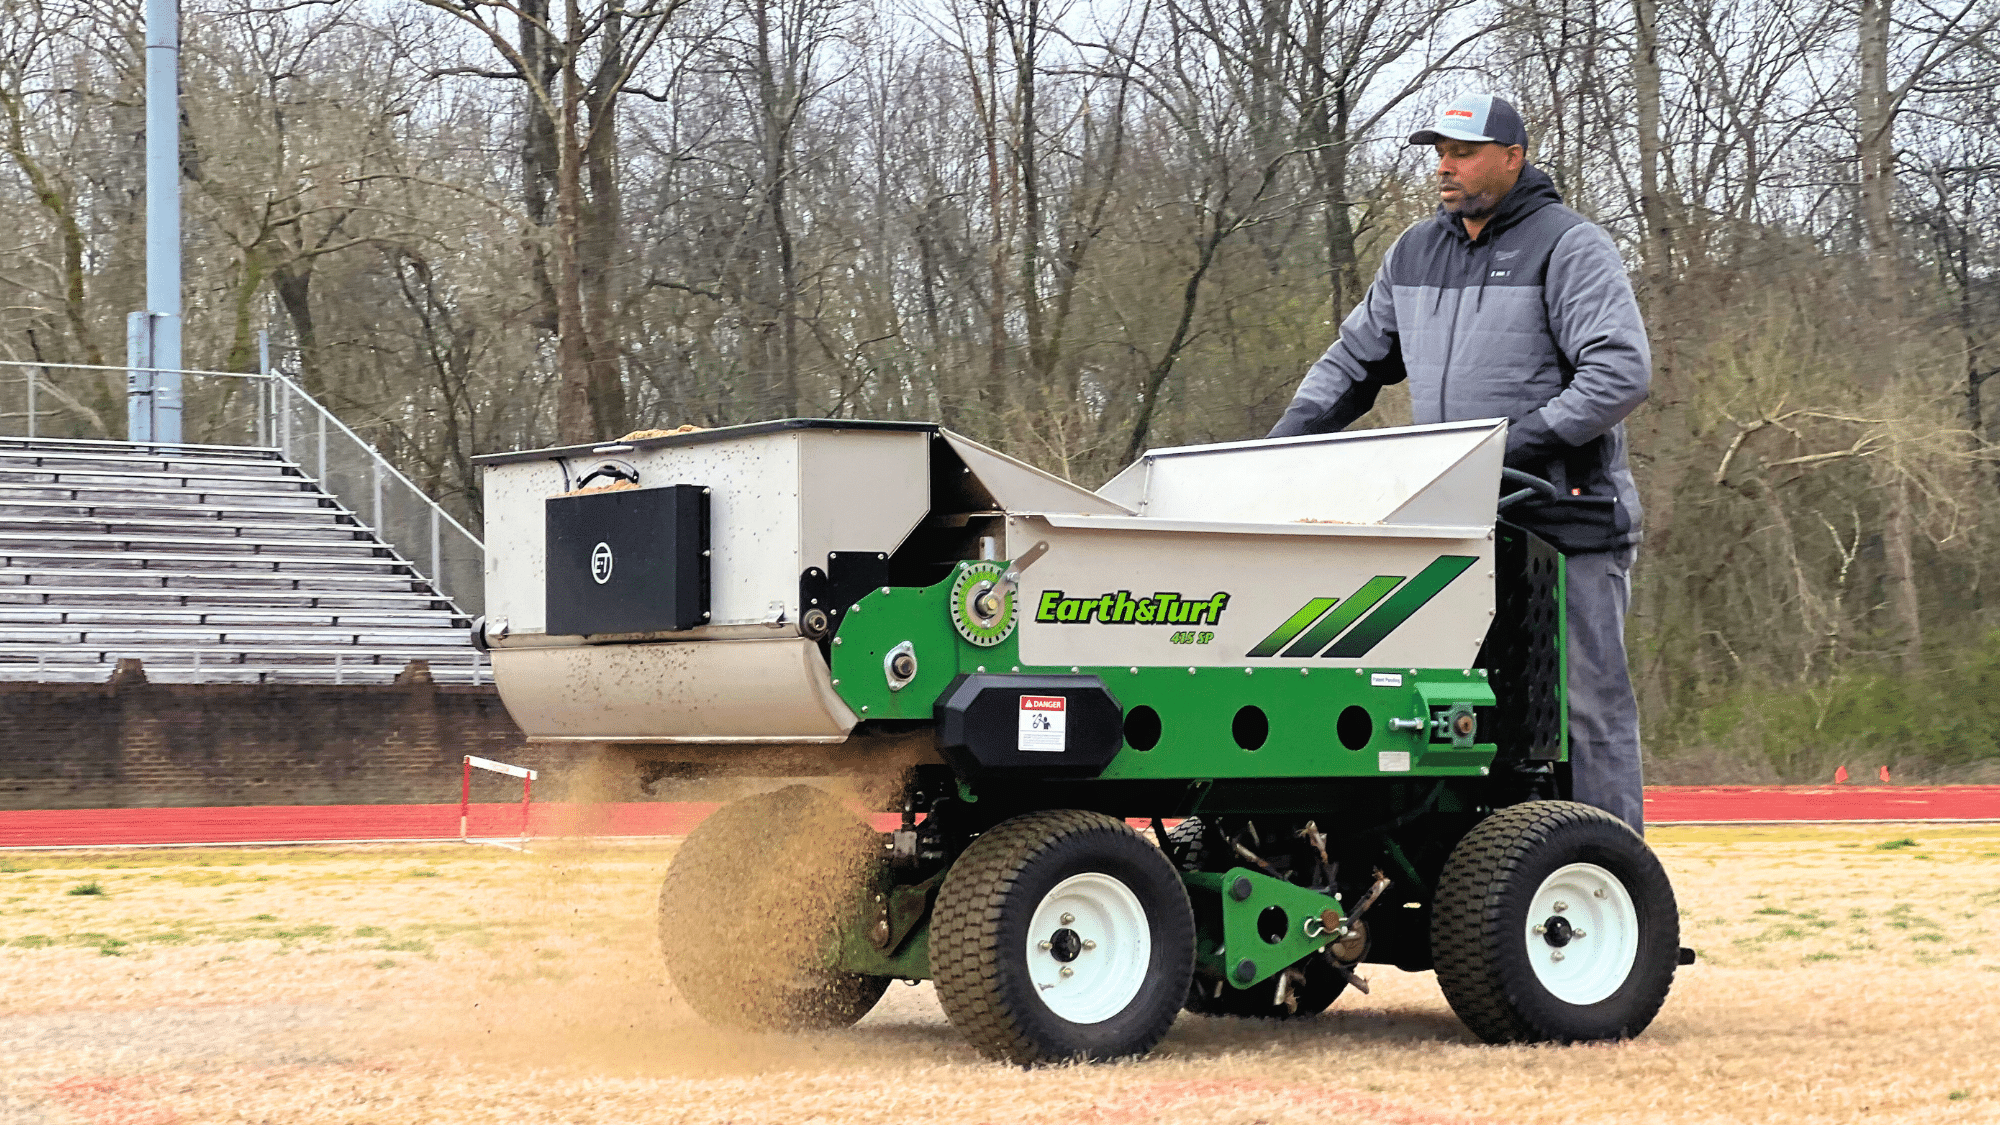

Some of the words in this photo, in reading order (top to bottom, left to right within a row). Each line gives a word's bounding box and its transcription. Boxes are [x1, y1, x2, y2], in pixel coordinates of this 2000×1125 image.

[1035, 590, 1231, 625] Earth&Turf
[1170, 631, 1196, 644] 415
[1196, 631, 1214, 644] SP
[1033, 700, 1062, 709] DANGER
